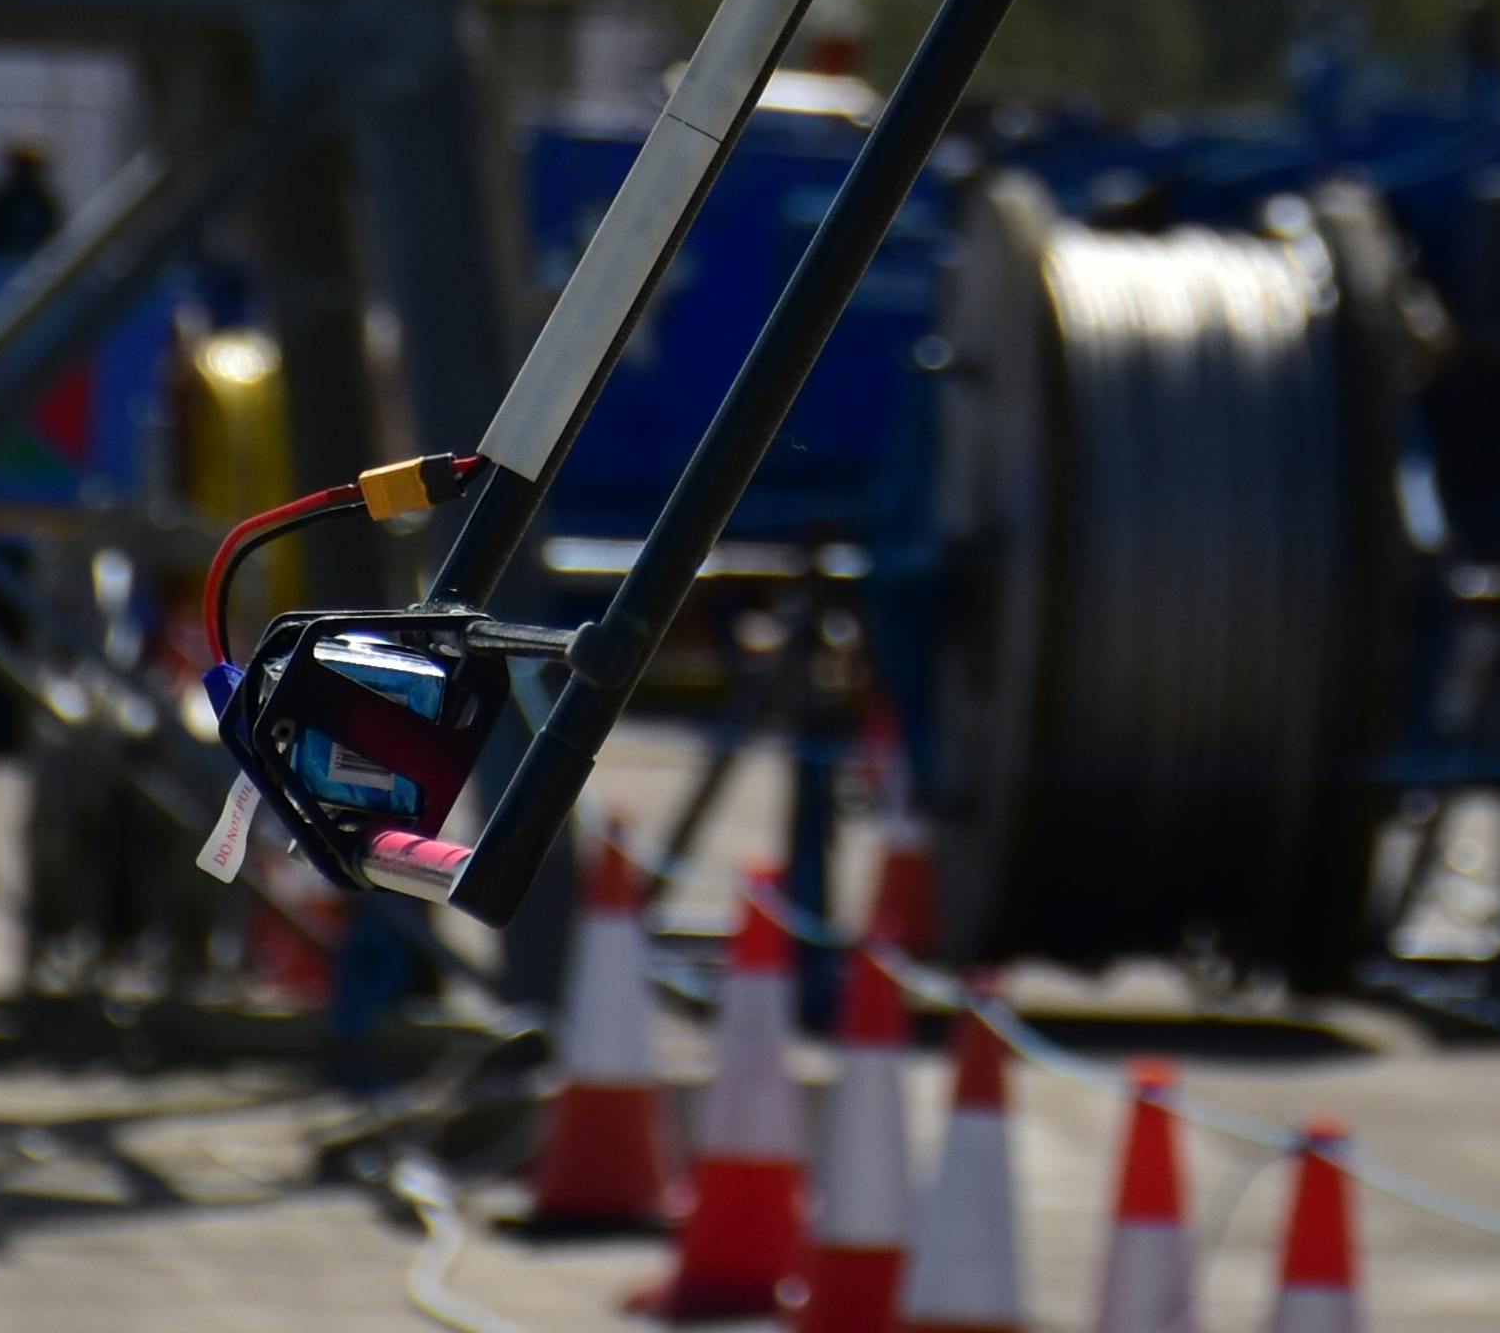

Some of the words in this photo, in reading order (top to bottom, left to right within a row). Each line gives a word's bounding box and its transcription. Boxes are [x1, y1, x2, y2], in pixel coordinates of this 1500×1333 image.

[213, 843, 233, 866] DO
[227, 810, 241, 843] NOT
[235, 784, 255, 811] PUL
